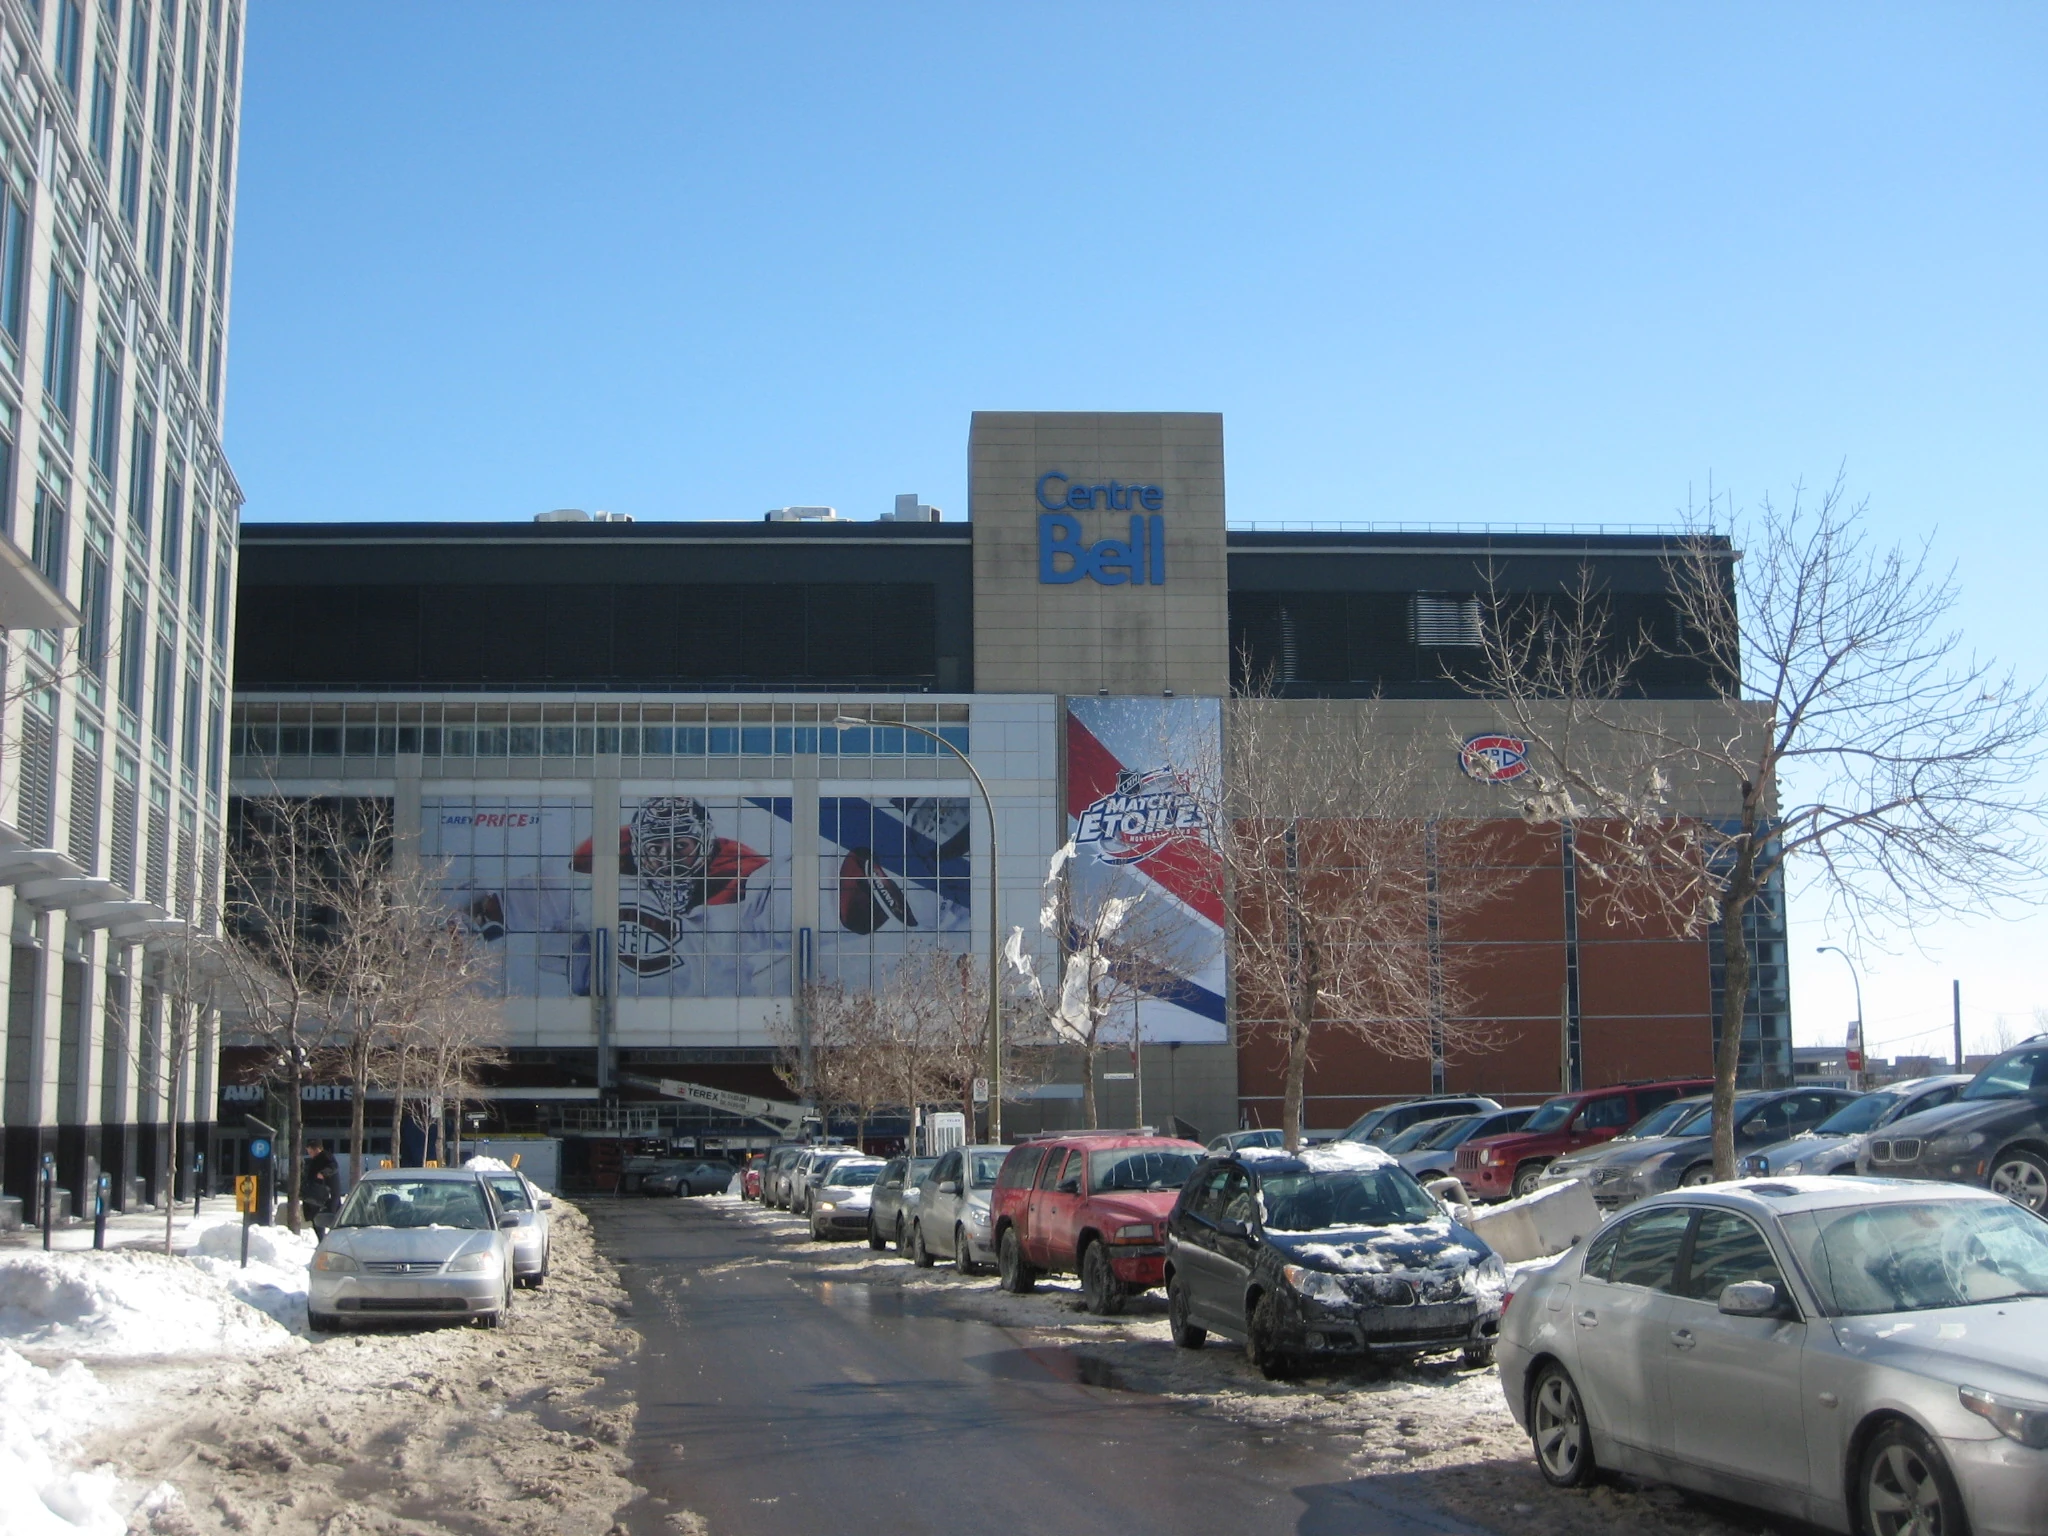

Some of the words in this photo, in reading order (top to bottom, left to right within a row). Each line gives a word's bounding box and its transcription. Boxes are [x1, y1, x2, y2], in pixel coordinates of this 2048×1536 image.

[1036, 470, 1164, 511] Centre
[1039, 513, 1165, 586] Bell
[475, 813, 529, 828] PRICE
[301, 1085, 354, 1101] ORTS
[688, 1087, 719, 1102] TEREX
